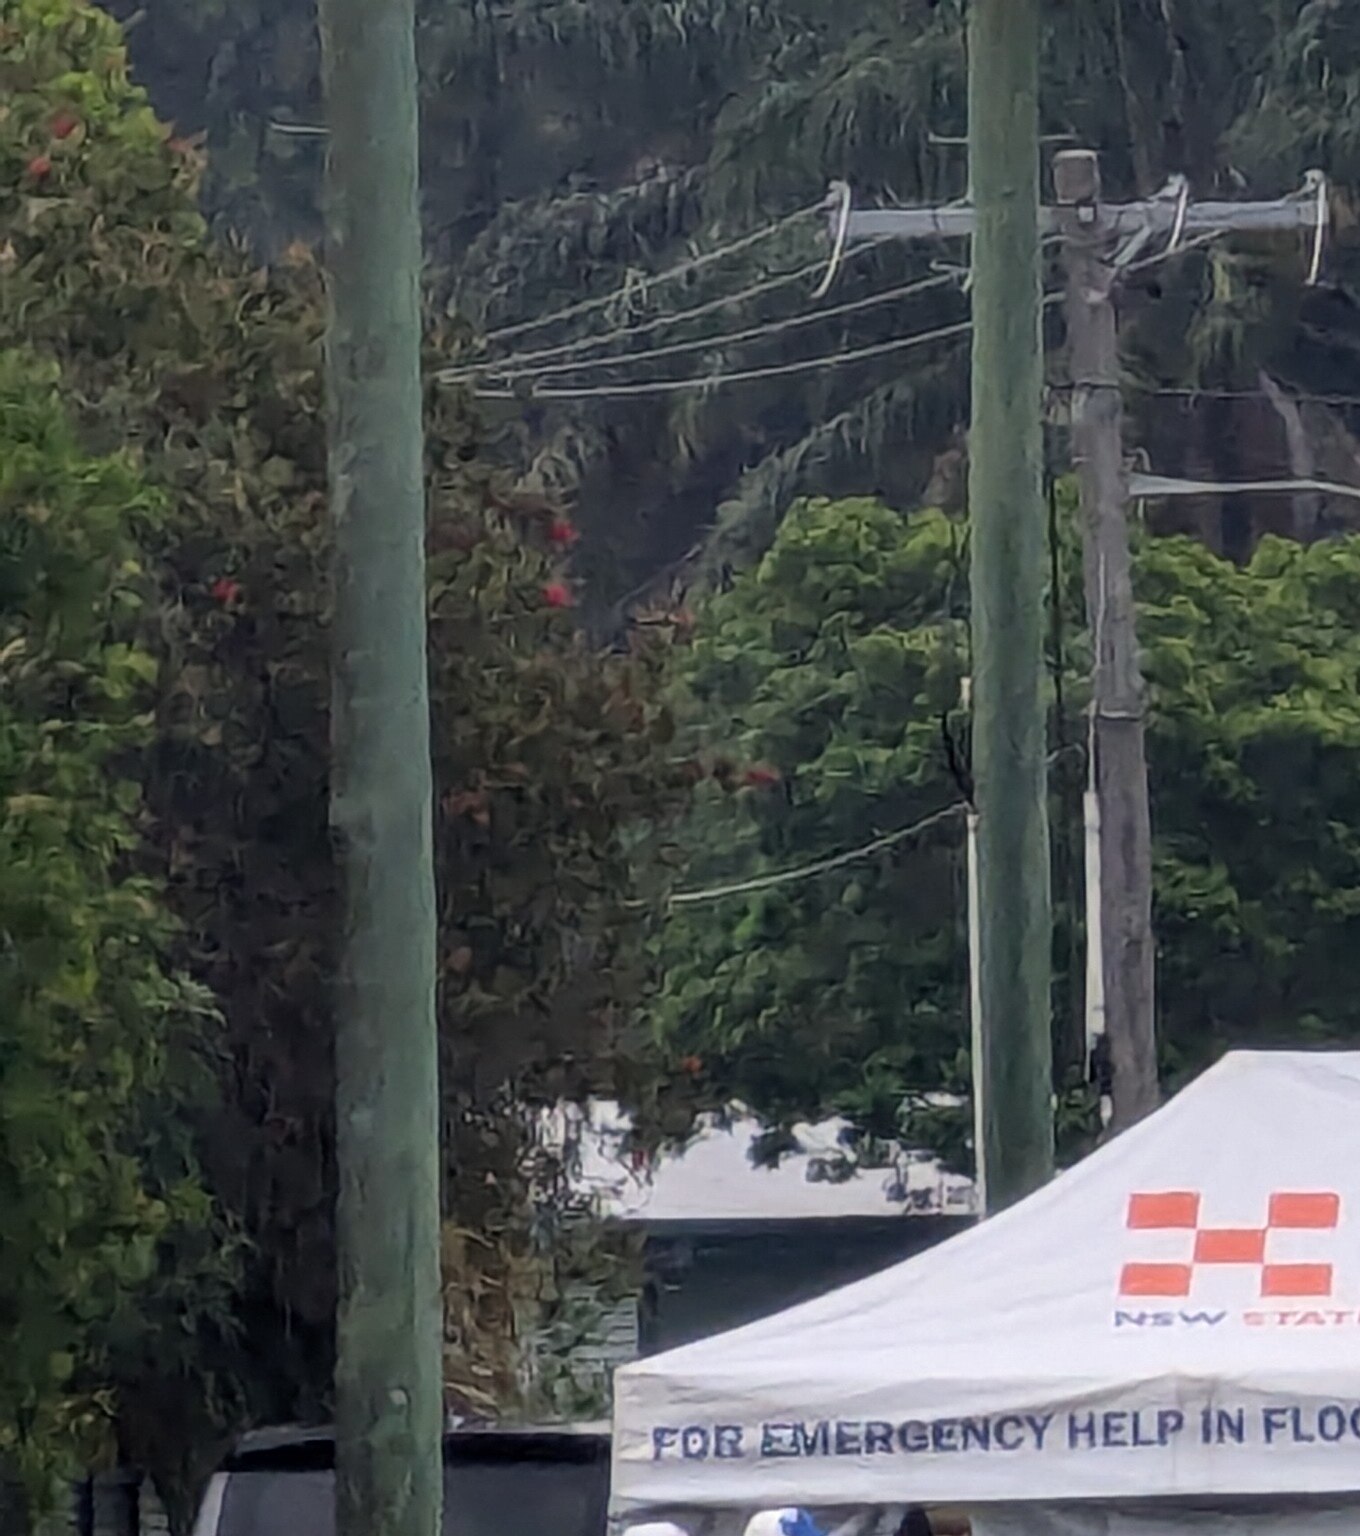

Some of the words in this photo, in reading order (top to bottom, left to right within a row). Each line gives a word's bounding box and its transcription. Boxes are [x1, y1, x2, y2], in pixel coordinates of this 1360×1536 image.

[1115, 1310, 1227, 1327] NSW
[651, 1425, 745, 1461] FOR
[760, 1413, 1054, 1457] EMERGENCY
[1068, 1407, 1185, 1448] HELP
[1200, 1407, 1245, 1445] IN
